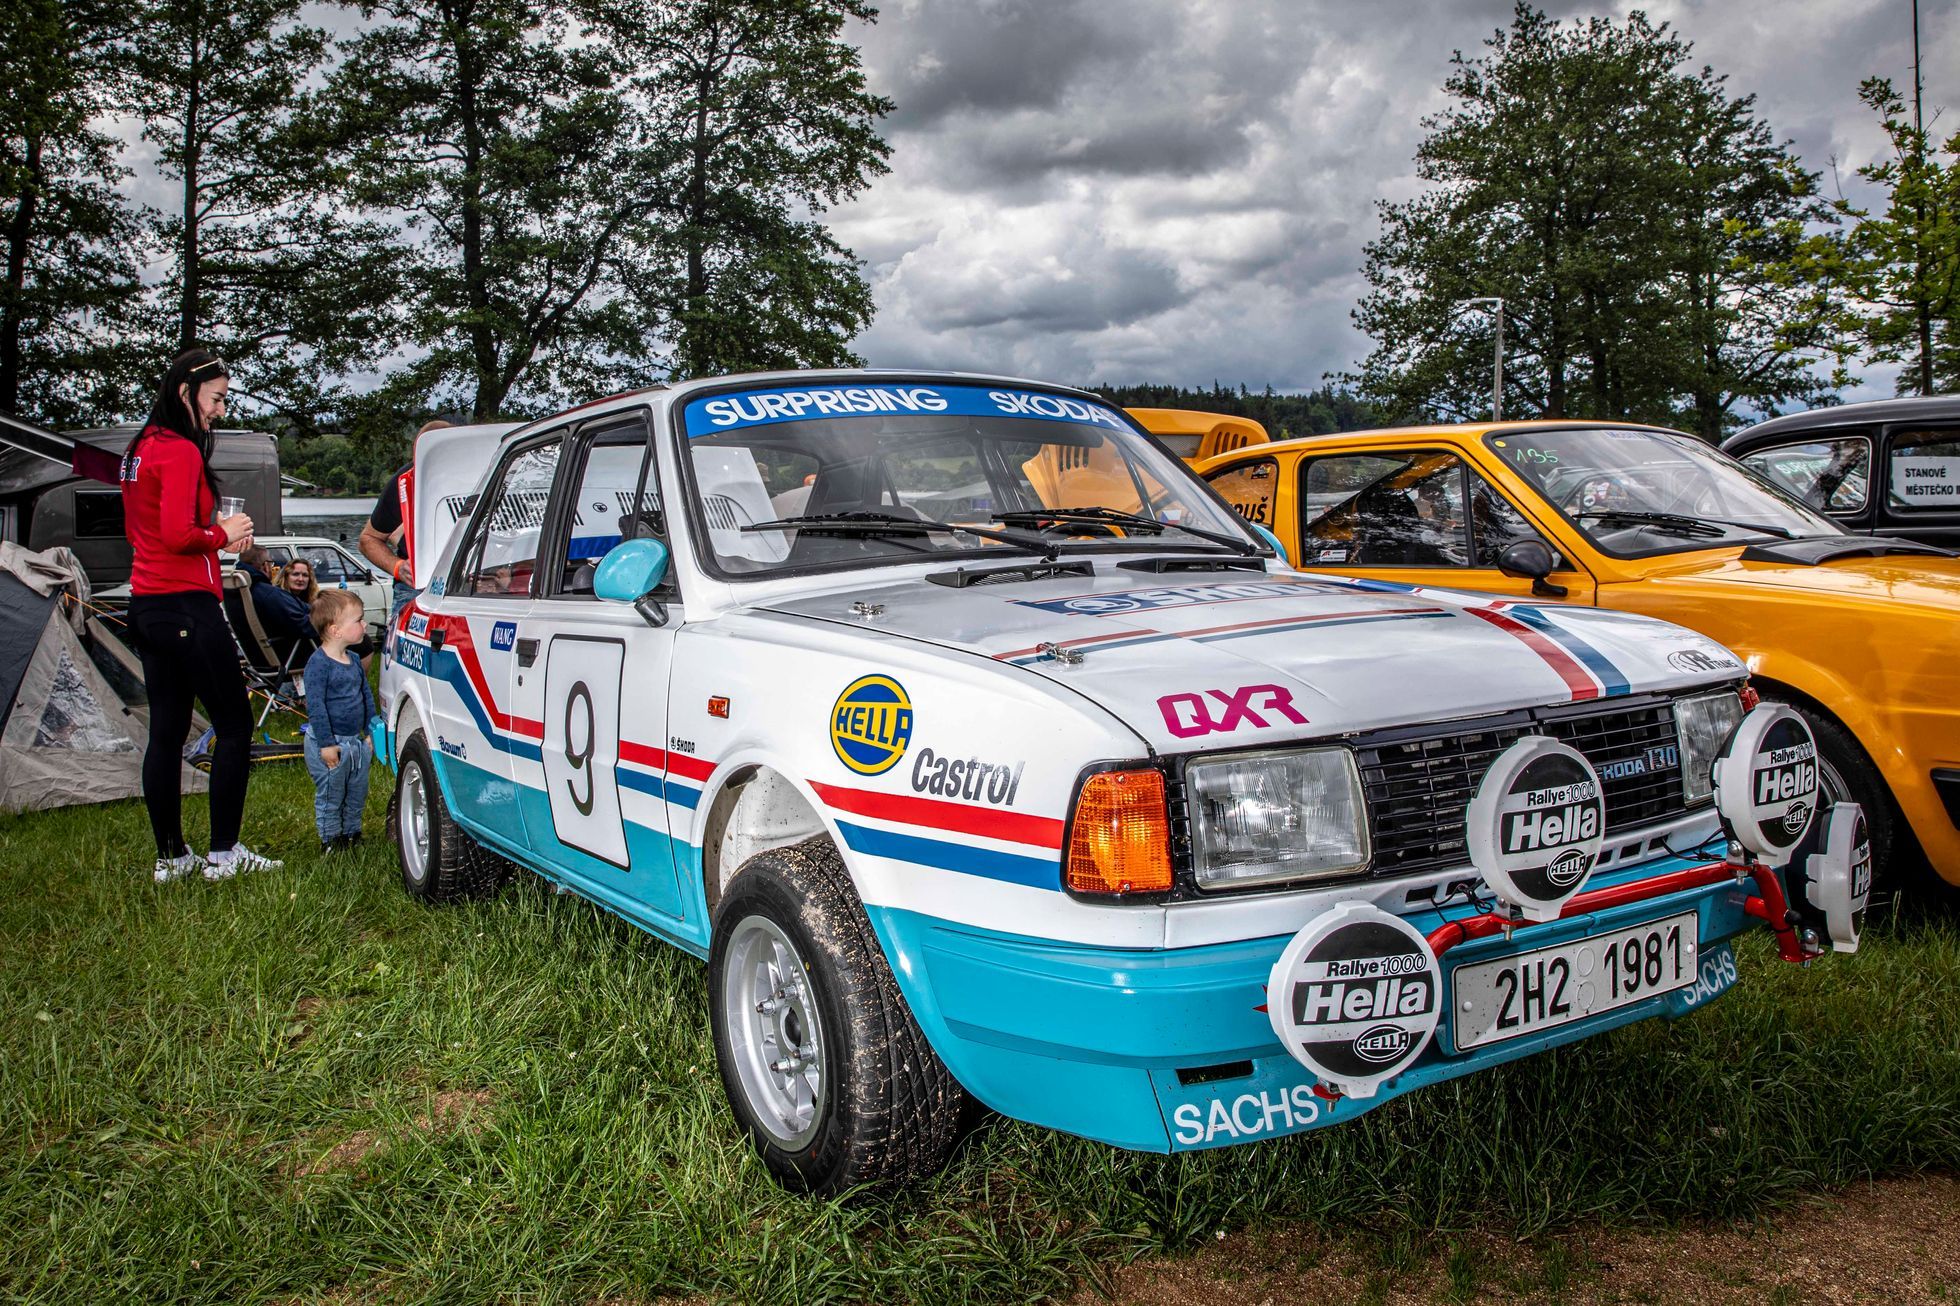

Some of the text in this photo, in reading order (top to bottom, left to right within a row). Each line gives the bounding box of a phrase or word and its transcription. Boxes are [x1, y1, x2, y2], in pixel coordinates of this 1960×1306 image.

[705, 389, 948, 426] SURPRISING
[1515, 448, 1558, 464] 135
[1905, 464, 1946, 478] STANOVÉ
[1905, 484, 1954, 496] MĚSTEČKO
[493, 626, 514, 646] WANG
[402, 641, 424, 670] SACHS
[1157, 684, 1310, 739] QXR
[836, 706, 913, 751] HELLA
[438, 735, 462, 758] Barum
[565, 680, 595, 816] 9
[1647, 745, 1679, 771] 130
[1770, 742, 1813, 764] Rallye 1000
[911, 747, 1026, 806] Castrol
[1759, 762, 1814, 803] Hella
[1527, 781, 1596, 808] Rallye 1000
[1509, 804, 1597, 851] Hella
[1785, 807, 1807, 825] HELLA
[1551, 855, 1586, 875] HELLA
[1326, 953, 1426, 977] Rallye 1000
[1495, 925, 1681, 1030] 2H2 1981
[1303, 978, 1427, 1023] Hella
[1358, 1031, 1409, 1049] HELLA
[1174, 1085, 1319, 1145] SACHS
